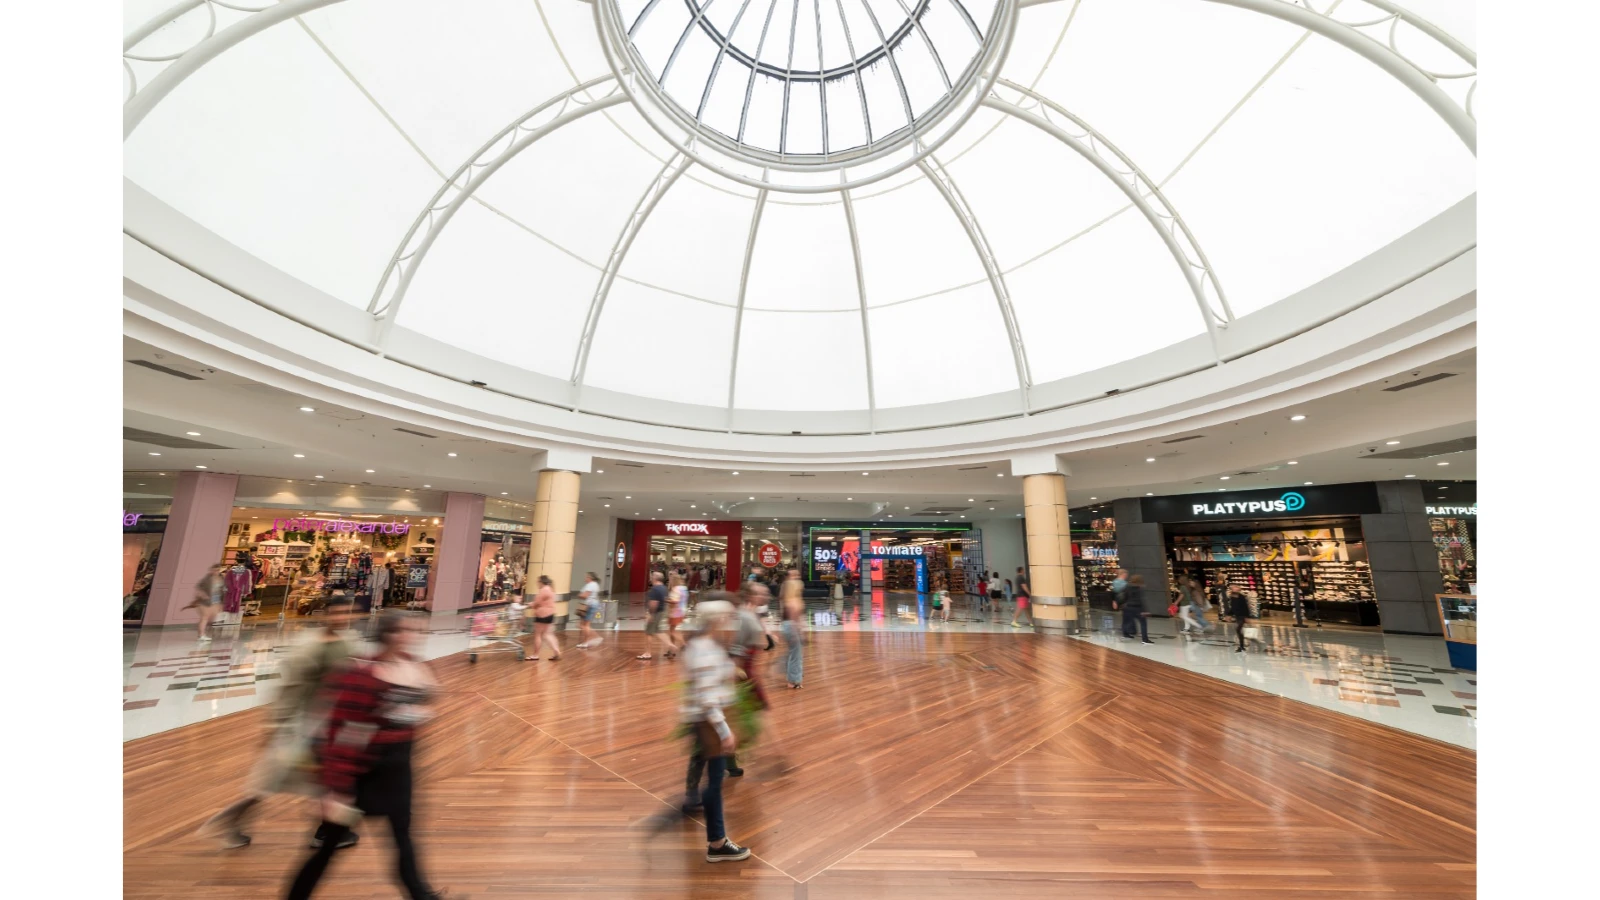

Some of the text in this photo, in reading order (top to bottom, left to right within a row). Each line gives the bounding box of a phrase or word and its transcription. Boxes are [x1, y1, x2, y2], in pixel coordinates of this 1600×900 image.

[1192, 500, 1287, 515] PLATYPUS
[814, 549, 838, 560] 50%
[409, 567, 428, 576] 20%
